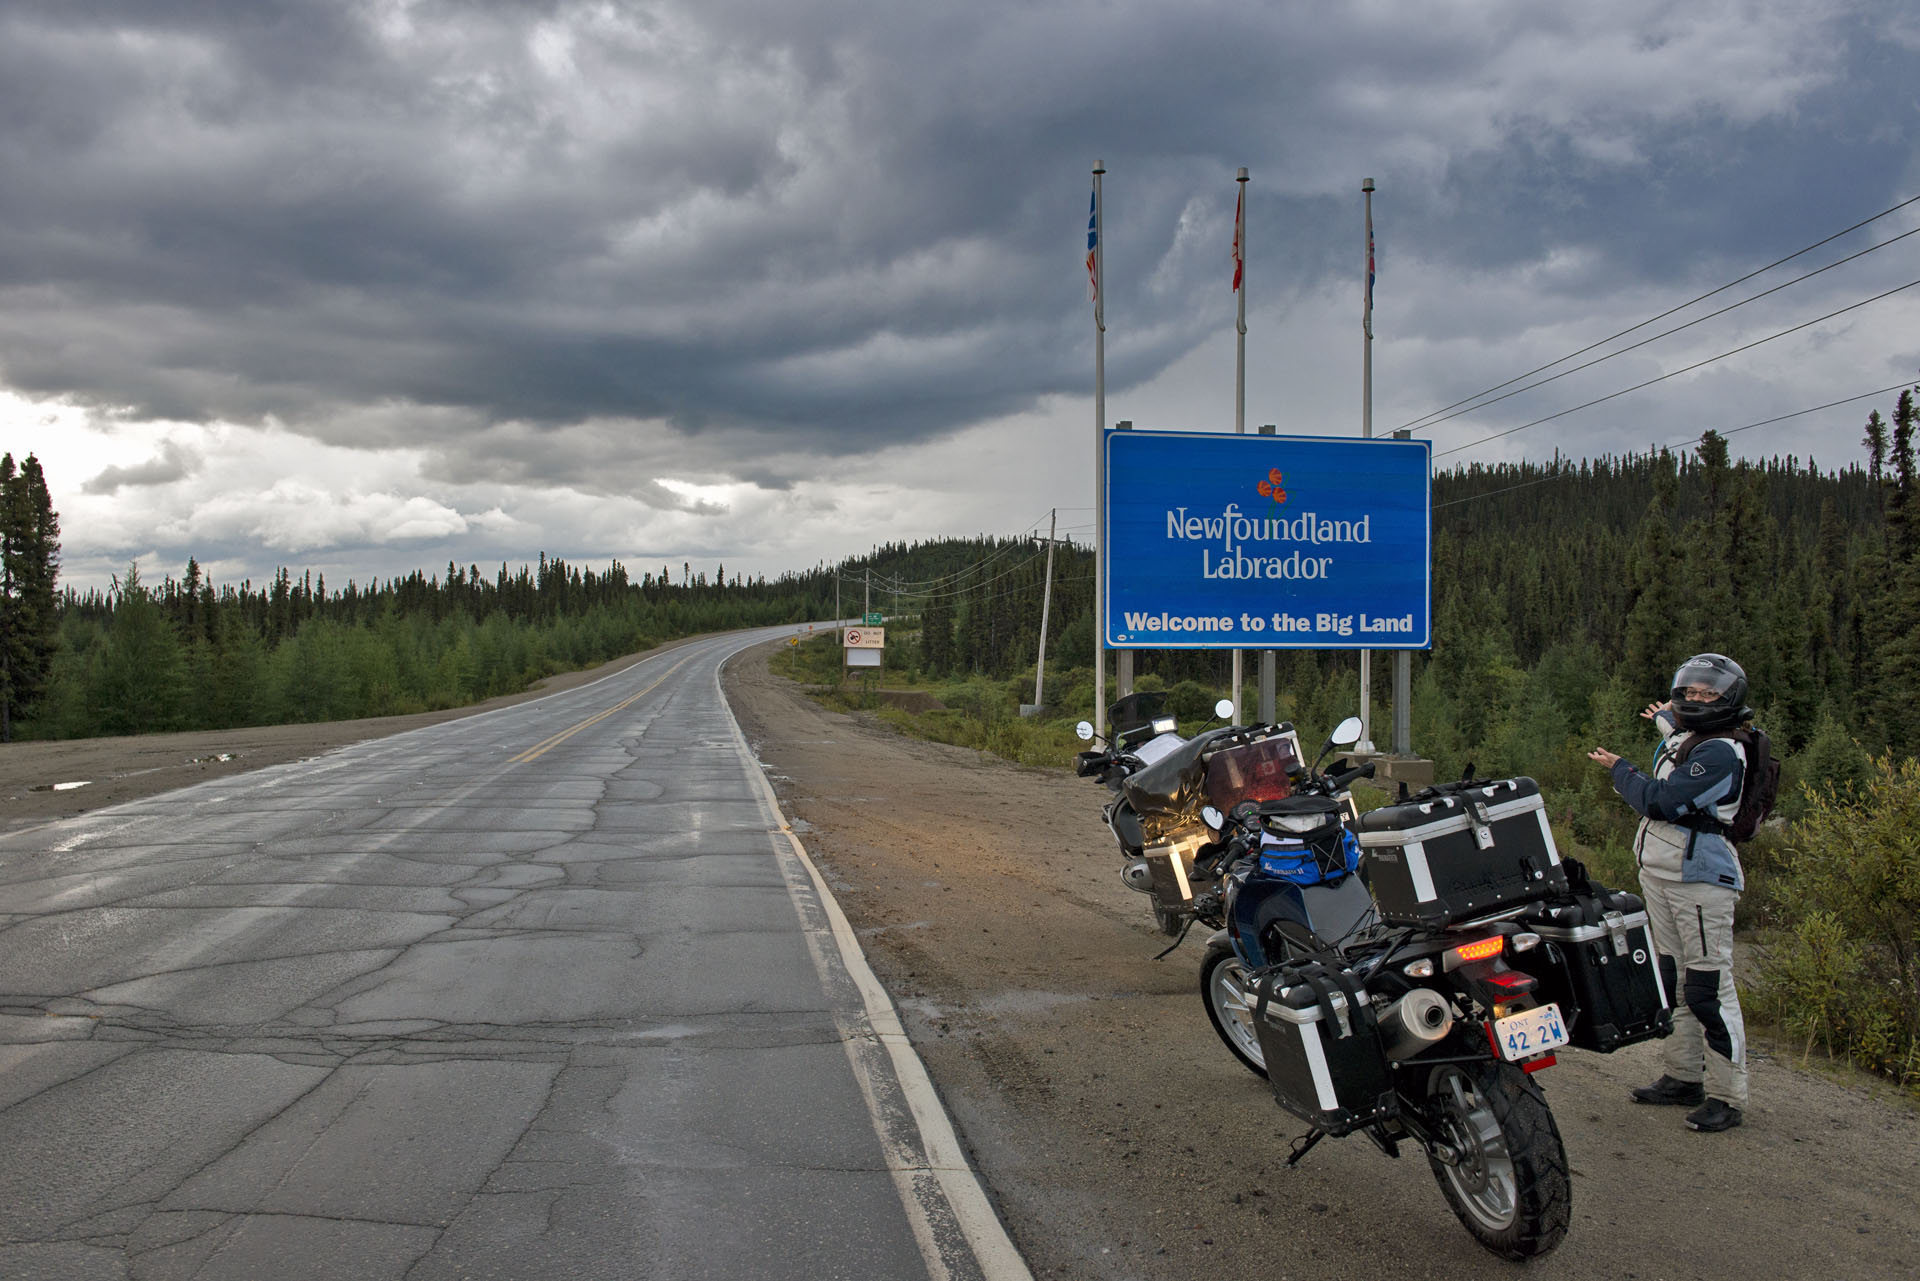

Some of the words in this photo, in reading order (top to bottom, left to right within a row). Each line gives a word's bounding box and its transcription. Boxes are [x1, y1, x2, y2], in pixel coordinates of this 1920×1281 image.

[1166, 503, 1372, 553] Newfoundland
[1202, 545, 1333, 580] Labrador
[1124, 611, 1234, 633] Welcome
[1240, 612, 1266, 633] to
[1271, 612, 1311, 633] the
[1315, 612, 1354, 637] Big
[1359, 613, 1414, 634] Land
[1508, 1032, 1530, 1050] 42
[1537, 1020, 1562, 1044] 2W
